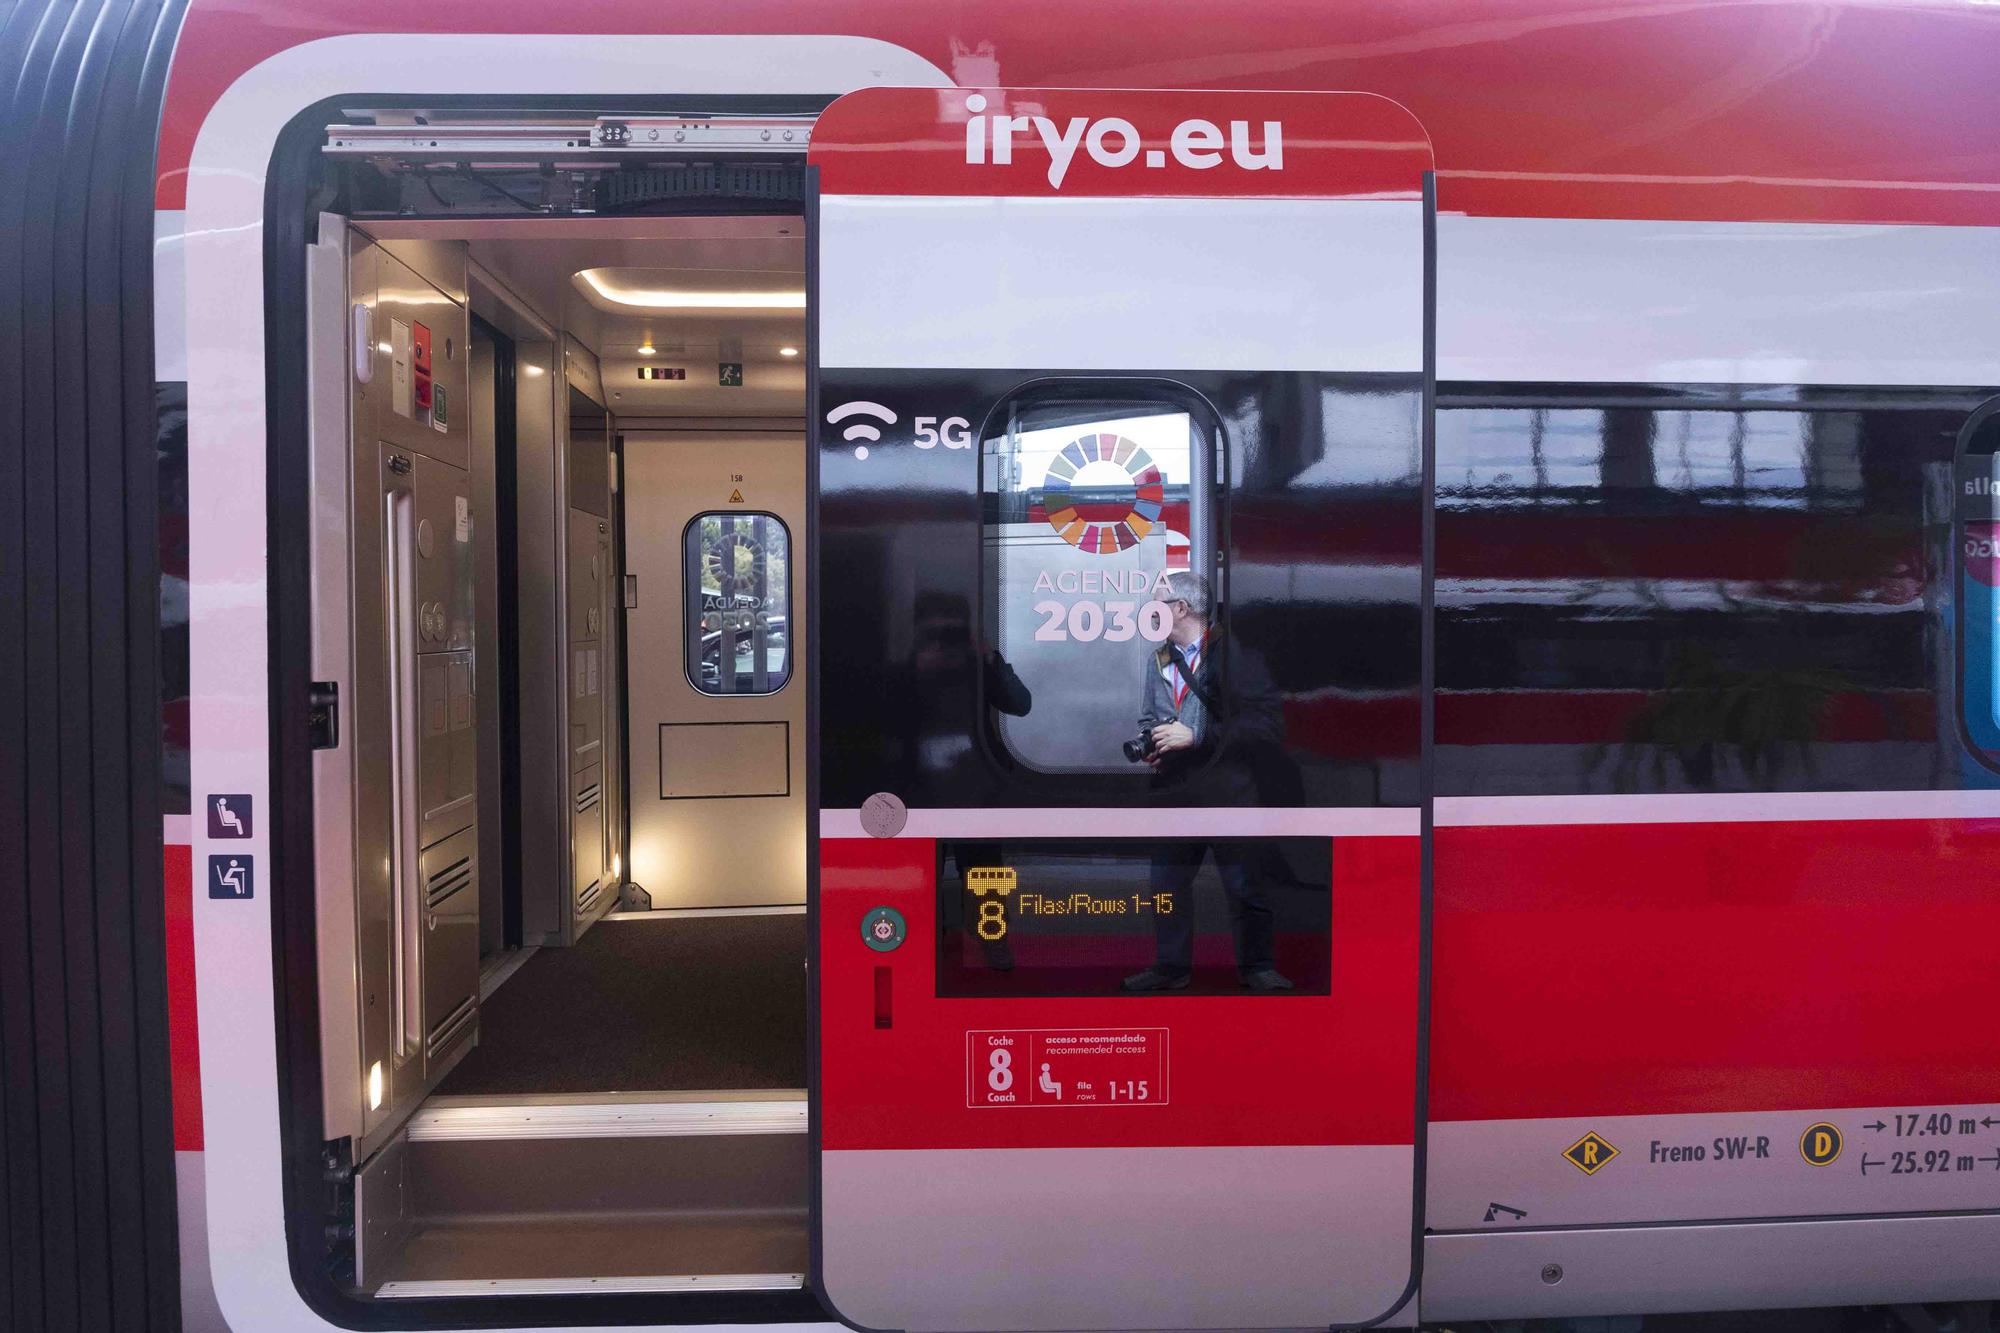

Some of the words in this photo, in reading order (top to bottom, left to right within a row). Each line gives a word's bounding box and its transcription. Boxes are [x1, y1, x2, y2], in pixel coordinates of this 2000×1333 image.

[966, 94, 1283, 190] iryo.eu
[913, 416, 972, 450] 5G
[1032, 569, 1175, 595] AGENDA
[1033, 600, 1175, 642] 2030
[1019, 894, 1127, 915] Filas/Rows
[1131, 893, 1174, 914] 1-15
[977, 901, 1007, 940] 8
[987, 1036, 1014, 1046] Coche
[1045, 1036, 1077, 1044] acceso
[1079, 1034, 1146, 1043] recomendado
[1046, 1044, 1113, 1054] recommended
[1115, 1045, 1146, 1054] access
[988, 1048, 1013, 1091] 8
[987, 1092, 1015, 1102] Coach
[1077, 1081, 1092, 1090] fila
[1109, 1081, 1148, 1100] 1-15
[1895, 1113, 1952, 1137] 17.40
[1958, 1118, 1976, 1135] m
[1584, 1141, 1598, 1165] R
[1650, 1141, 1706, 1163] Freno
[1713, 1136, 1770, 1161] SW-R
[1815, 1132, 1832, 1157] D
[1891, 1150, 1950, 1174] 25.92
[1956, 1155, 1974, 1171] m
